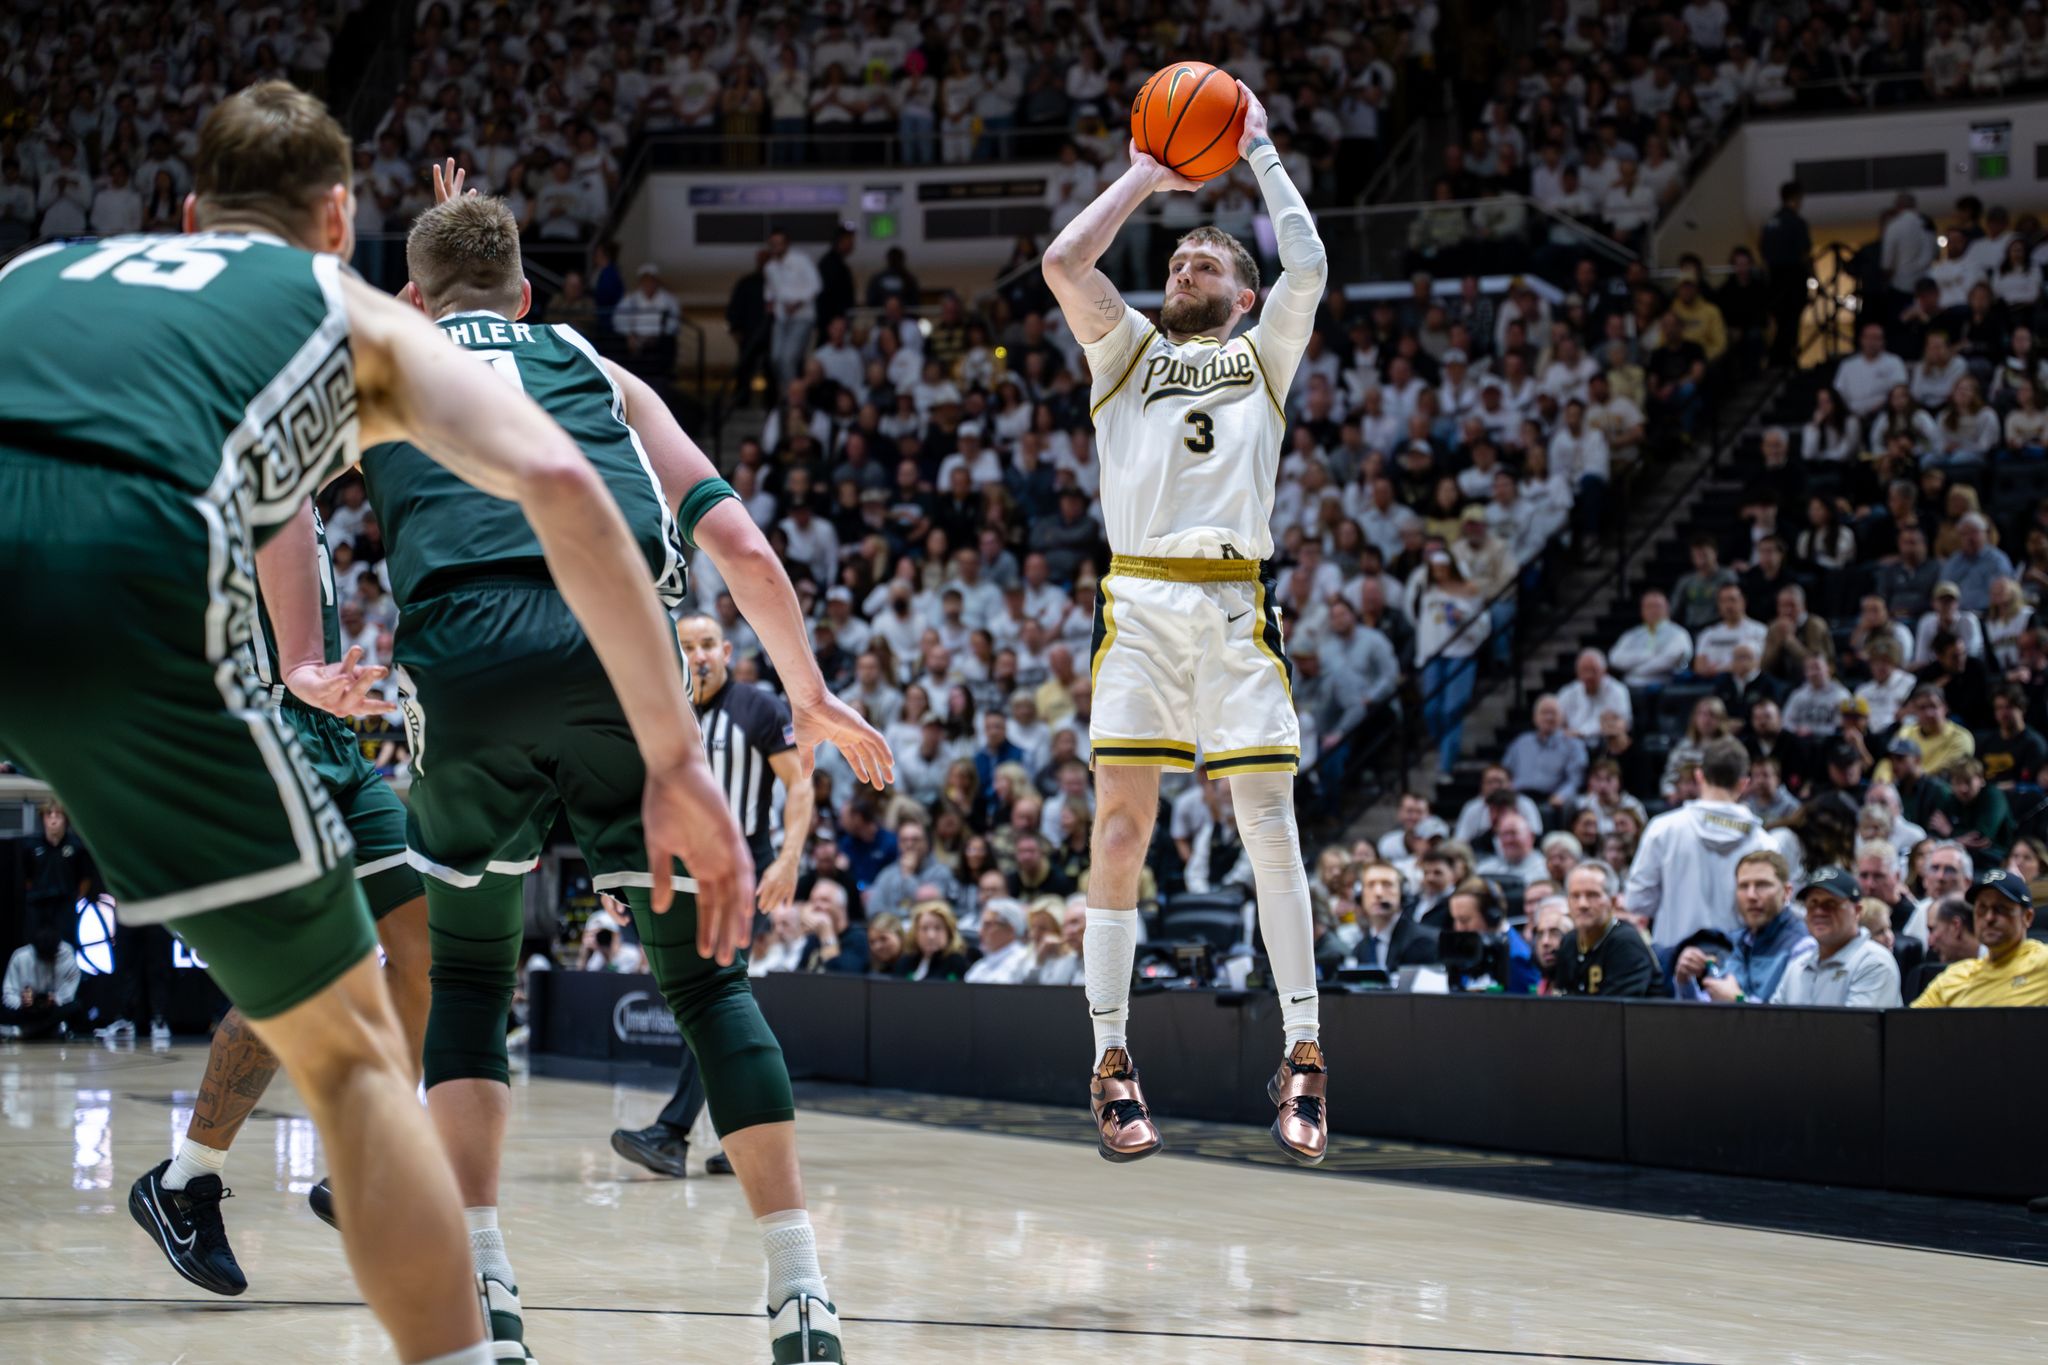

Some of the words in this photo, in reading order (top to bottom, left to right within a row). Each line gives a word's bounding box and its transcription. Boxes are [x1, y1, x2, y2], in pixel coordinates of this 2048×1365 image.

[59, 232, 254, 292] 15
[1141, 353, 1254, 394] Purdue
[1183, 409, 1215, 455] 3
[1588, 965, 1603, 994] P
